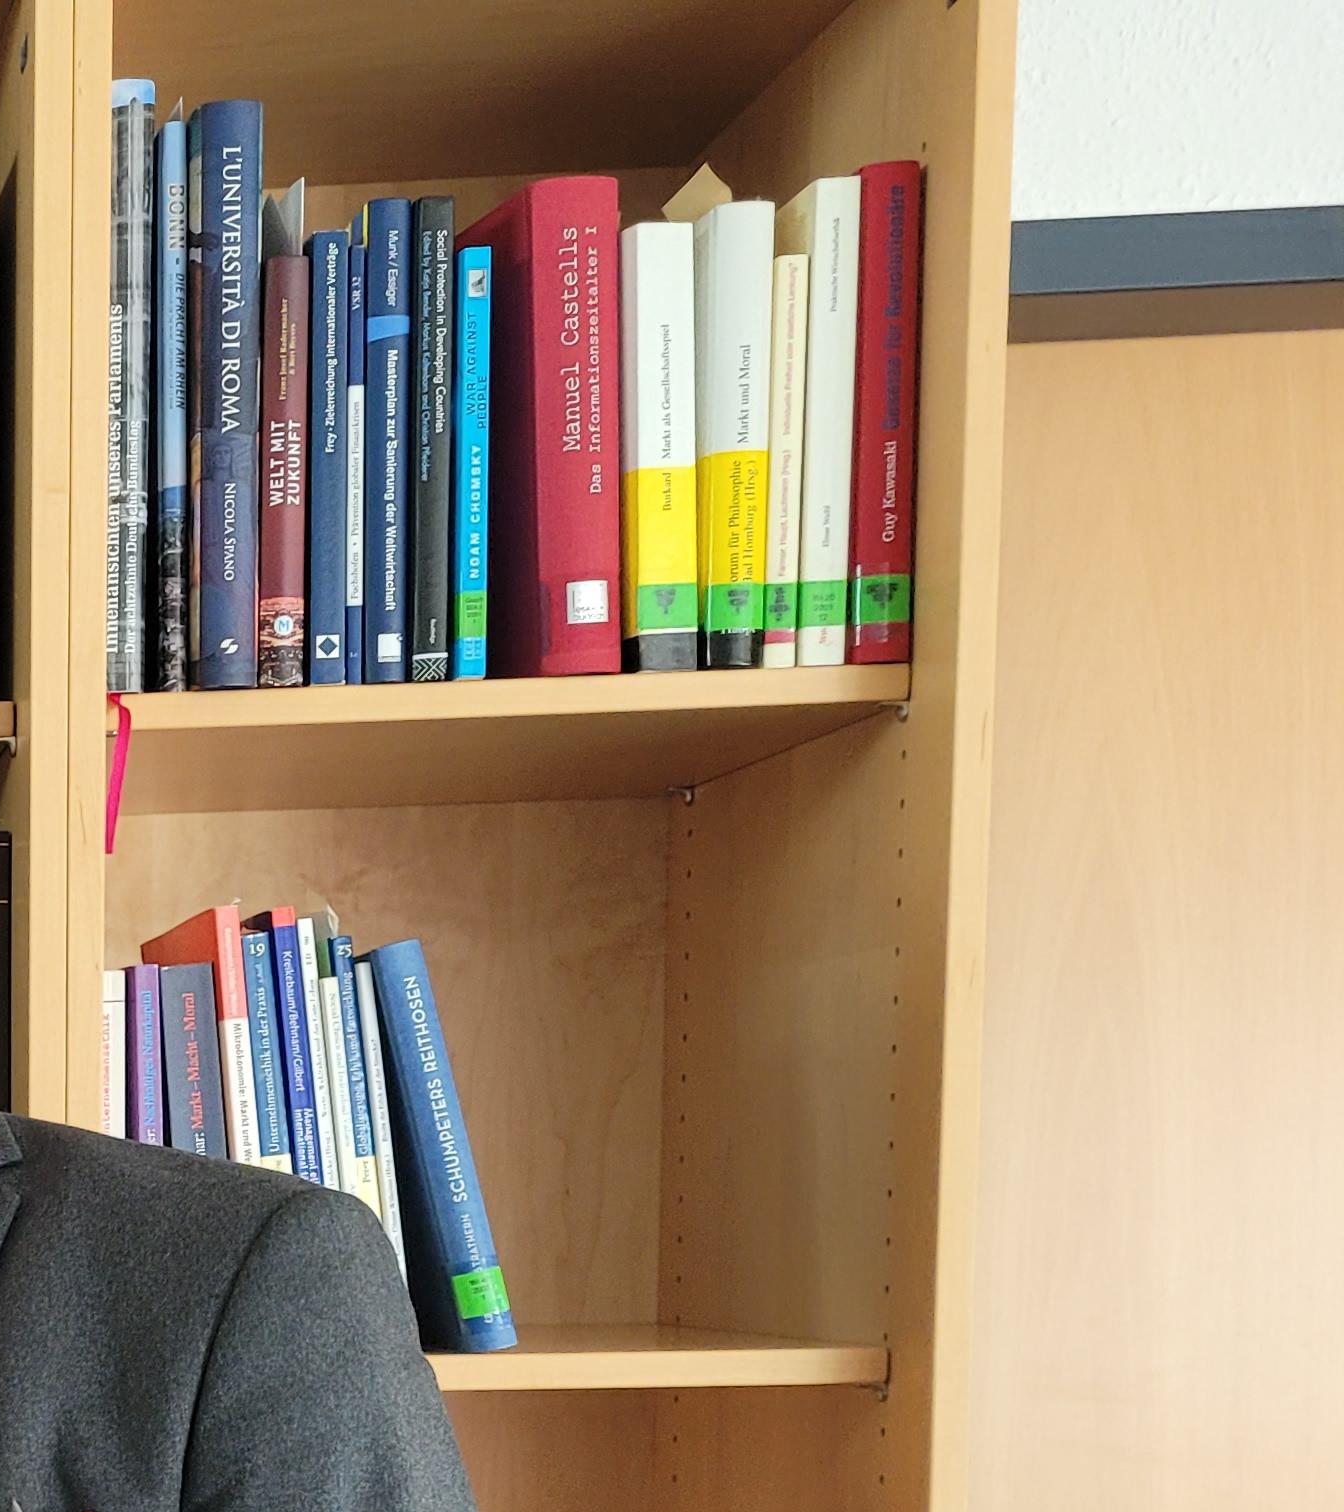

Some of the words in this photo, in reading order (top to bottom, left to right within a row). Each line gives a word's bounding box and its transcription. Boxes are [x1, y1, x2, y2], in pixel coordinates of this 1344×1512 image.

[167, 184, 185, 250] BONN
[221, 145, 243, 315] L'UNIVERSITÀ
[585, 225, 597, 235] I
[327, 242, 339, 286] Verträge
[388, 230, 399, 262] Munk
[436, 229, 448, 263] Social
[174, 272, 185, 295] DIE
[385, 269, 399, 307] Essiger
[436, 264, 447, 313] Protection
[558, 226, 579, 346] Castells
[175, 297, 186, 347] PRACHT
[221, 323, 242, 349] DI
[326, 286, 337, 359] Internationaler
[436, 313, 446, 325] in
[176, 350, 186, 371] AM
[433, 328, 447, 384] Developing
[466, 312, 477, 380] AGAINST
[586, 246, 601, 453] Informationszeitalter
[738, 344, 751, 381] Moral
[175, 372, 186, 410] RHEIN
[221, 357, 241, 433] ROMA
[325, 359, 338, 426] Zielerreichung
[385, 350, 398, 417] Masterplan
[466, 382, 476, 415] WAR
[477, 375, 487, 429] PEOPLE
[560, 361, 581, 452] Manuel
[739, 383, 750, 404] und
[385, 419, 396, 440] zur
[434, 385, 446, 434] Countries
[737, 406, 749, 444] Markt
[269, 420, 285, 455] MIT
[325, 434, 337, 453] Frey
[269, 458, 285, 507] WELT
[287, 420, 302, 505] ZUKUNFT
[384, 440, 397, 502] Sanierung
[469, 445, 481, 523] CHOMSKY
[589, 463, 602, 494] Das
[881, 440, 897, 514] Kawasaki
[223, 482, 236, 536] NICOLA
[385, 503, 396, 523] der
[882, 515, 896, 543] Guy
[223, 537, 236, 581] SPANO
[385, 524, 397, 611] Weltwirtschaft
[469, 532, 480, 579] NOAM
[249, 943, 266, 957] 19
[337, 944, 352, 956] 25
[256, 987, 268, 1014] Praxis
[283, 950, 305, 1092] Kreikebaum/Behnam/Gilbert
[404, 975, 438, 1073] REITHOSEN
[258, 1016, 269, 1036] der
[259, 1051, 279, 1152] Unternehmensethik
[426, 1077, 467, 1203] SCHUMPETERS
